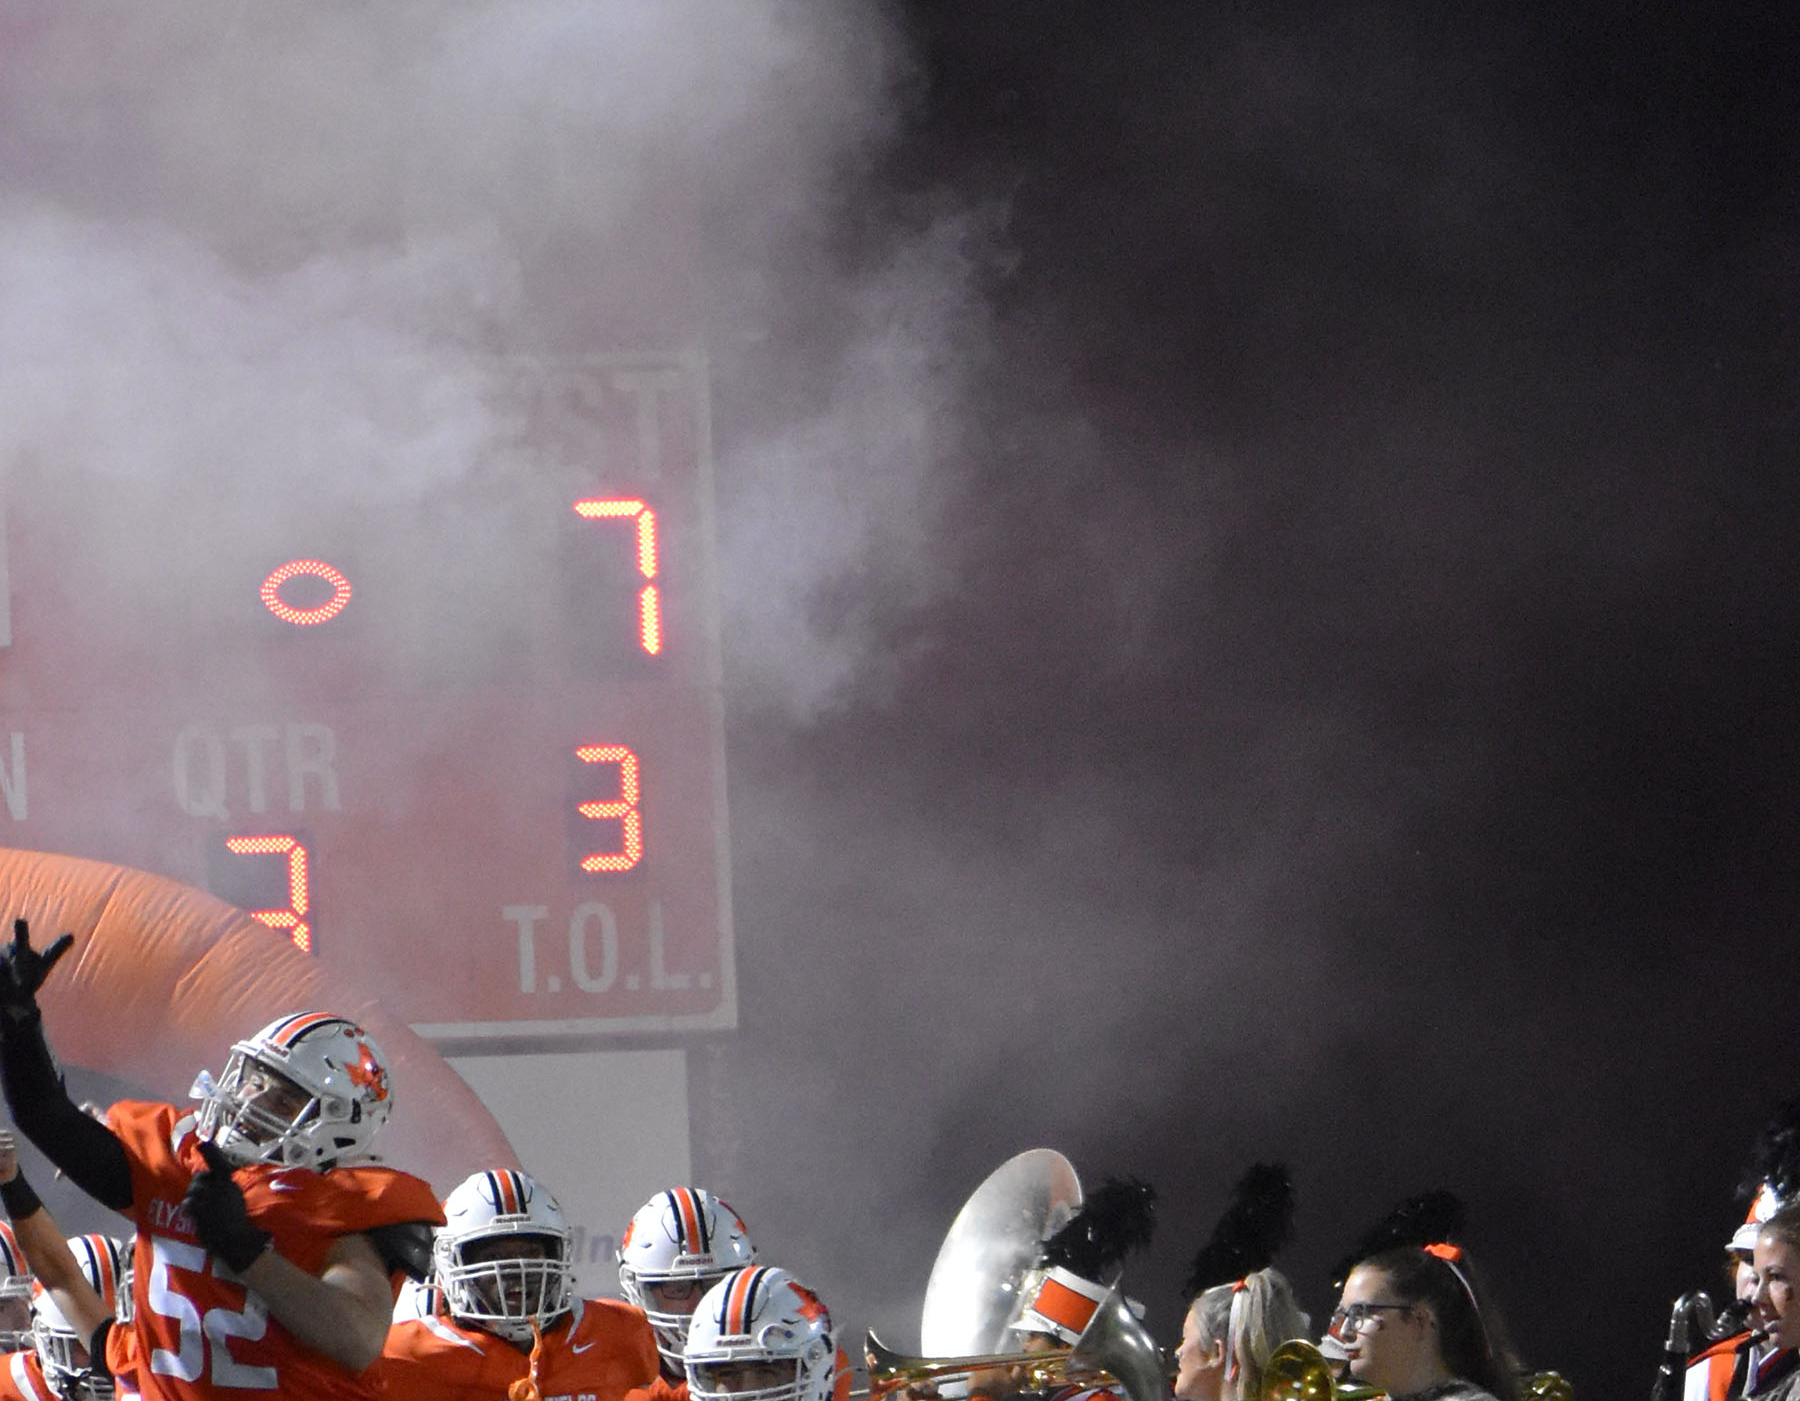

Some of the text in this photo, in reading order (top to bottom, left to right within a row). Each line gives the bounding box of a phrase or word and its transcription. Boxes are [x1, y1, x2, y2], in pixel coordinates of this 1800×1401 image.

[573, 498, 660, 657] 7
[171, 721, 341, 820] QTR
[575, 744, 642, 872] 3
[149, 1235, 279, 1390] 52
